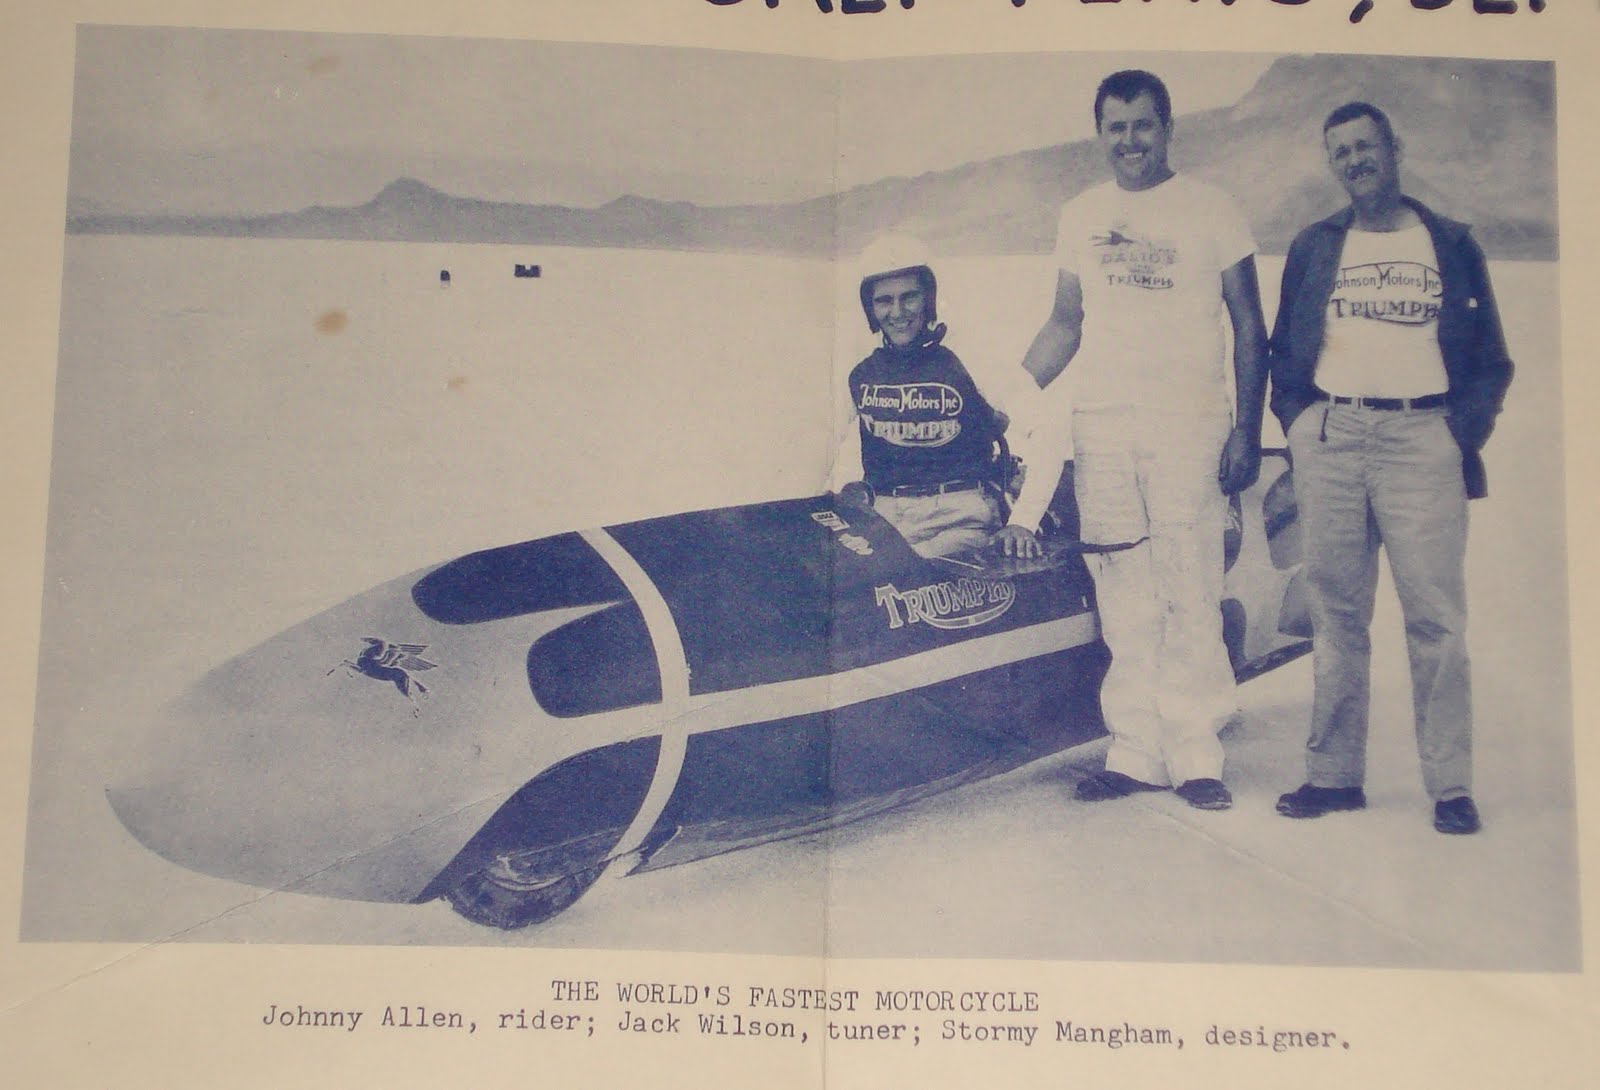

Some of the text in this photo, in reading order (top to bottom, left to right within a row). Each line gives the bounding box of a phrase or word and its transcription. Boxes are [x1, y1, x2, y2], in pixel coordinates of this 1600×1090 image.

[1107, 274, 1174, 288] TRIUMPH
[1331, 269, 1377, 290] ohnson
[1375, 263, 1422, 290] Motors
[1331, 298, 1439, 322] TRIUMPH
[858, 383, 900, 410] Johnson
[899, 386, 940, 413] Motors
[859, 413, 961, 446] TRIUMPH
[874, 577, 1016, 630] TRIUMPH
[552, 979, 1039, 1013] THE WORLD'S FASTEST MOTORCYCLE
[262, 1004, 1350, 1053] Johnny Allen, rider; Jack Wilson, tuner; Stormy Mangham, designer.
